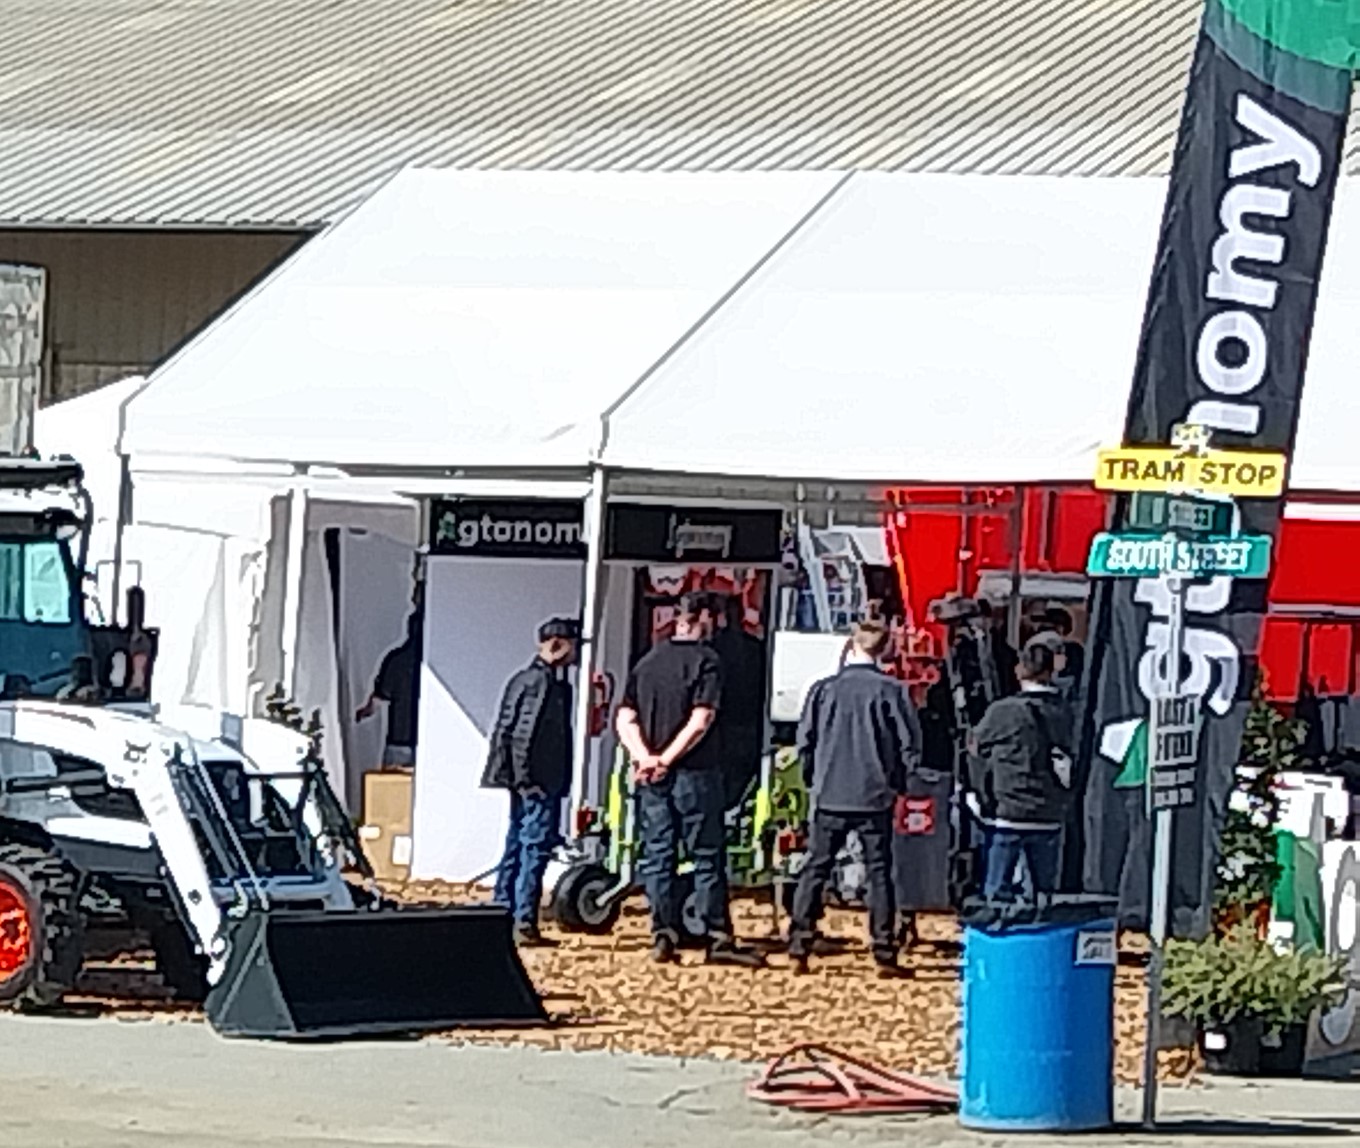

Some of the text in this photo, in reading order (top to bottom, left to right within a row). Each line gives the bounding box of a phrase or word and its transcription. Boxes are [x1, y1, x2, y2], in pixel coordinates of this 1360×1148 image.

[1103, 458, 1277, 486] TRAM STOP
[436, 511, 585, 547] Agtonom
[1106, 538, 1175, 572] SOUTH
